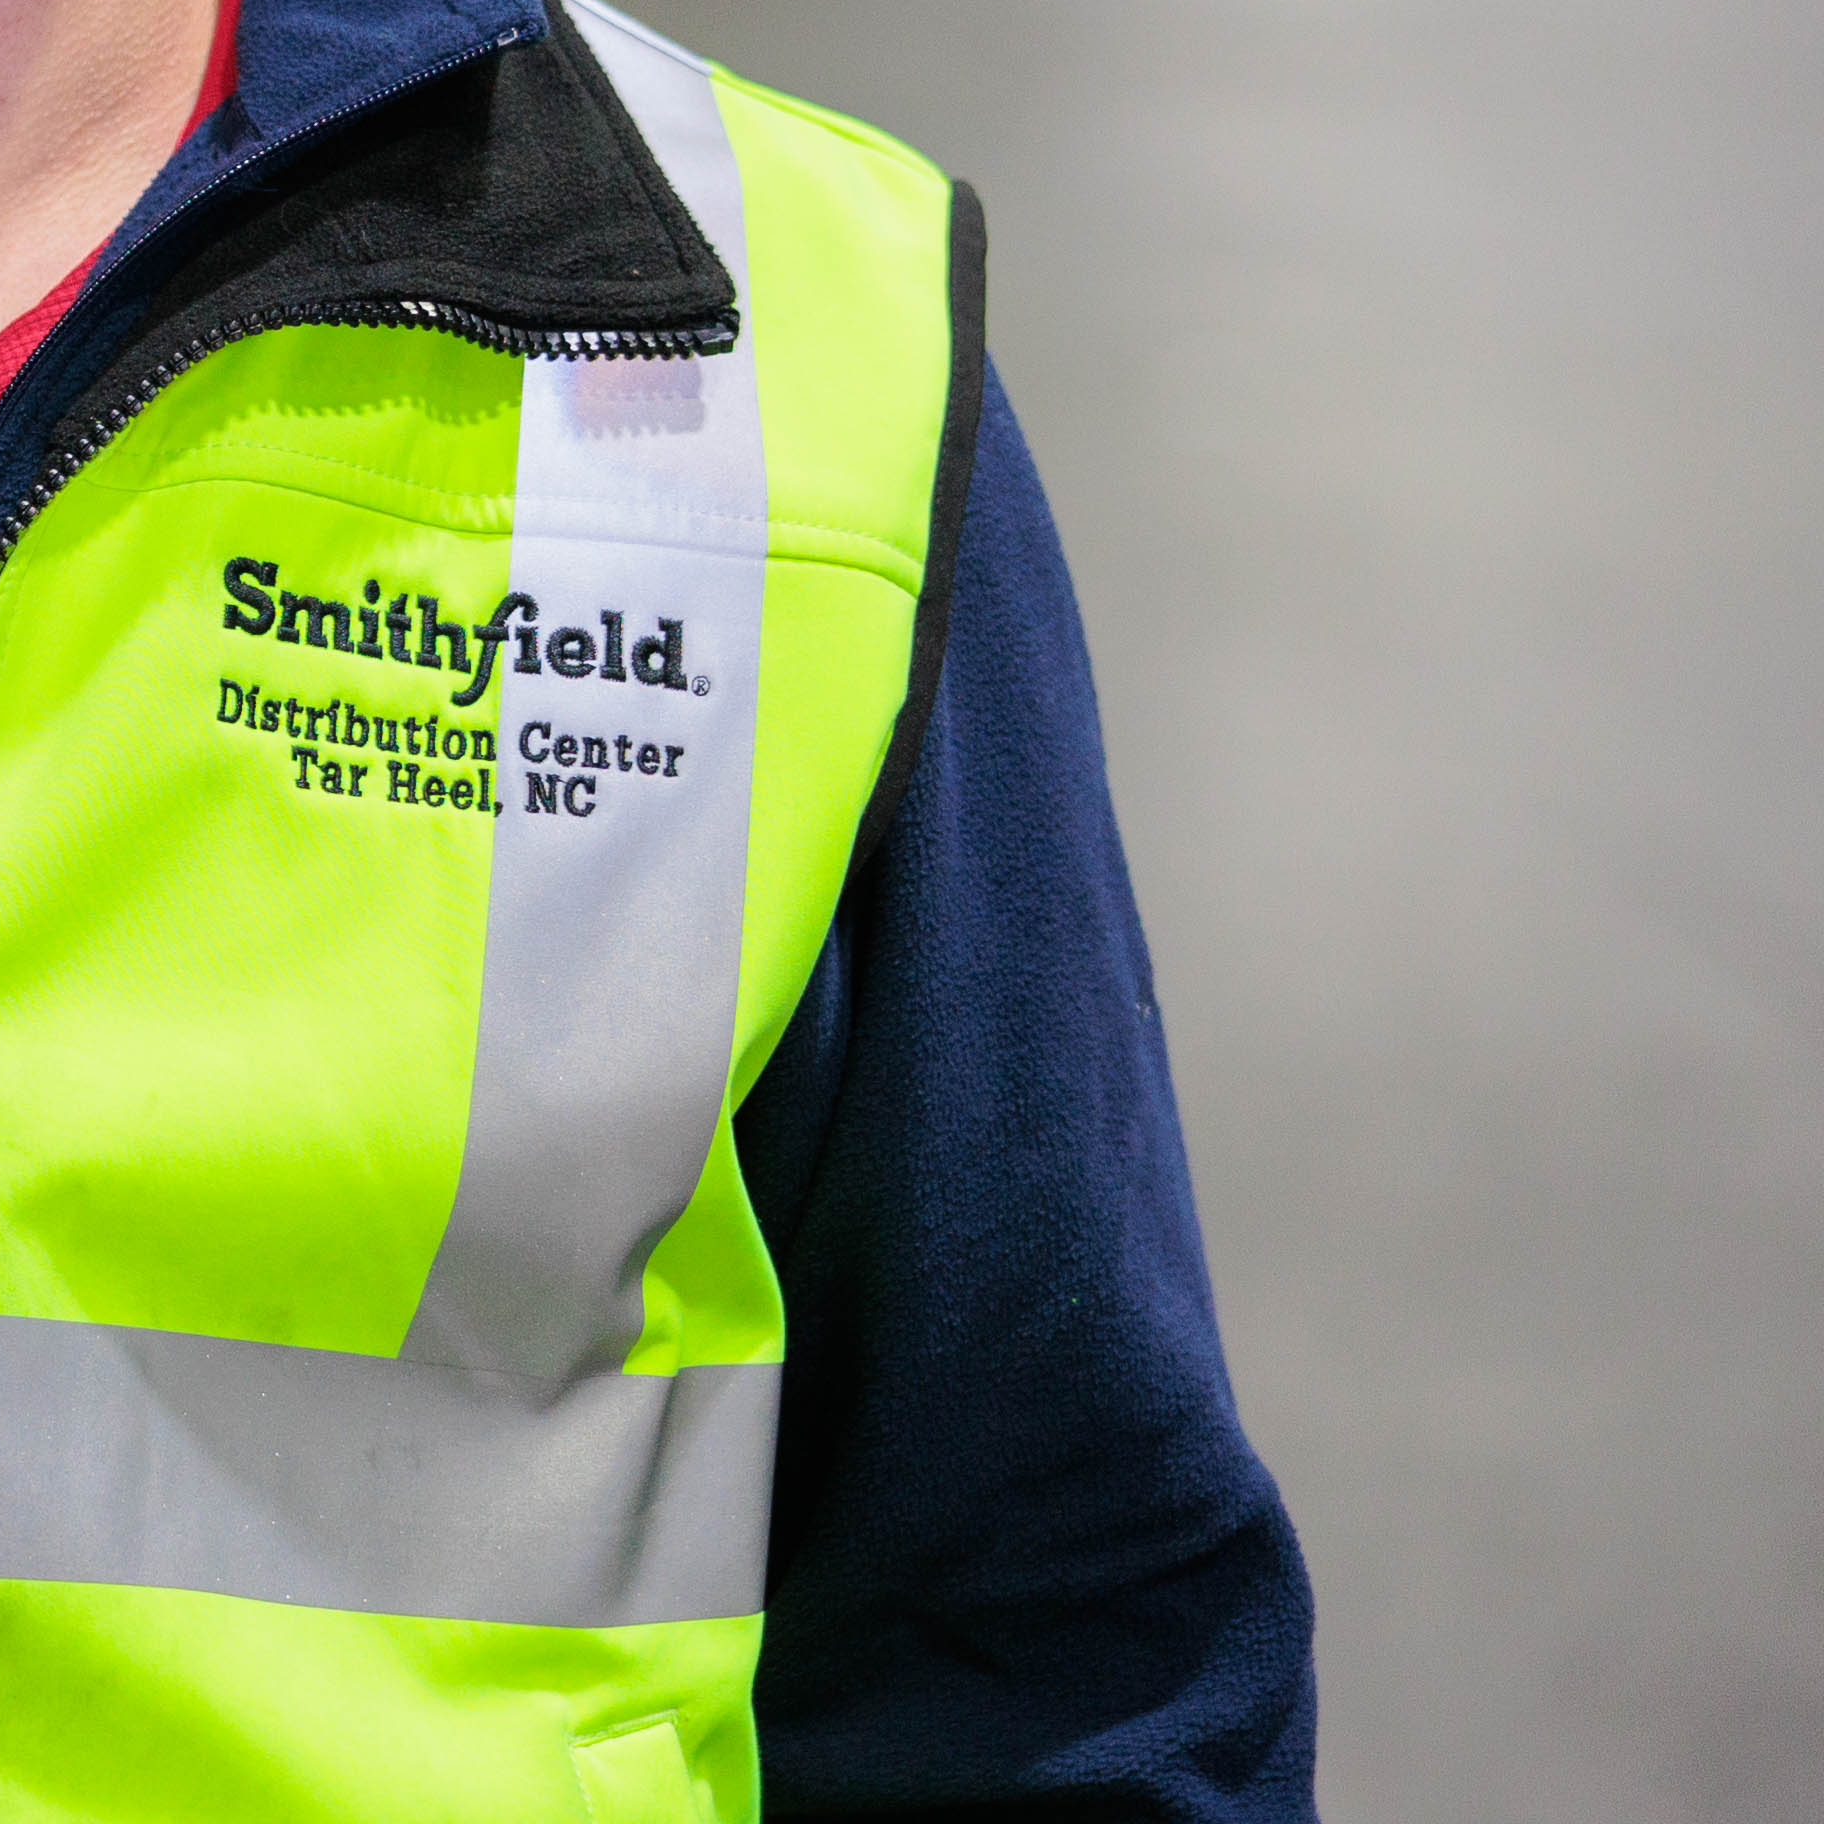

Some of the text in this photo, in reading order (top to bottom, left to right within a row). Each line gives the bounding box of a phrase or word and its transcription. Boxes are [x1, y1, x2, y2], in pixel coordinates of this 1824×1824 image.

[216, 678, 685, 778] Distribution Center
[290, 745, 597, 818] Tar Heel, NC
